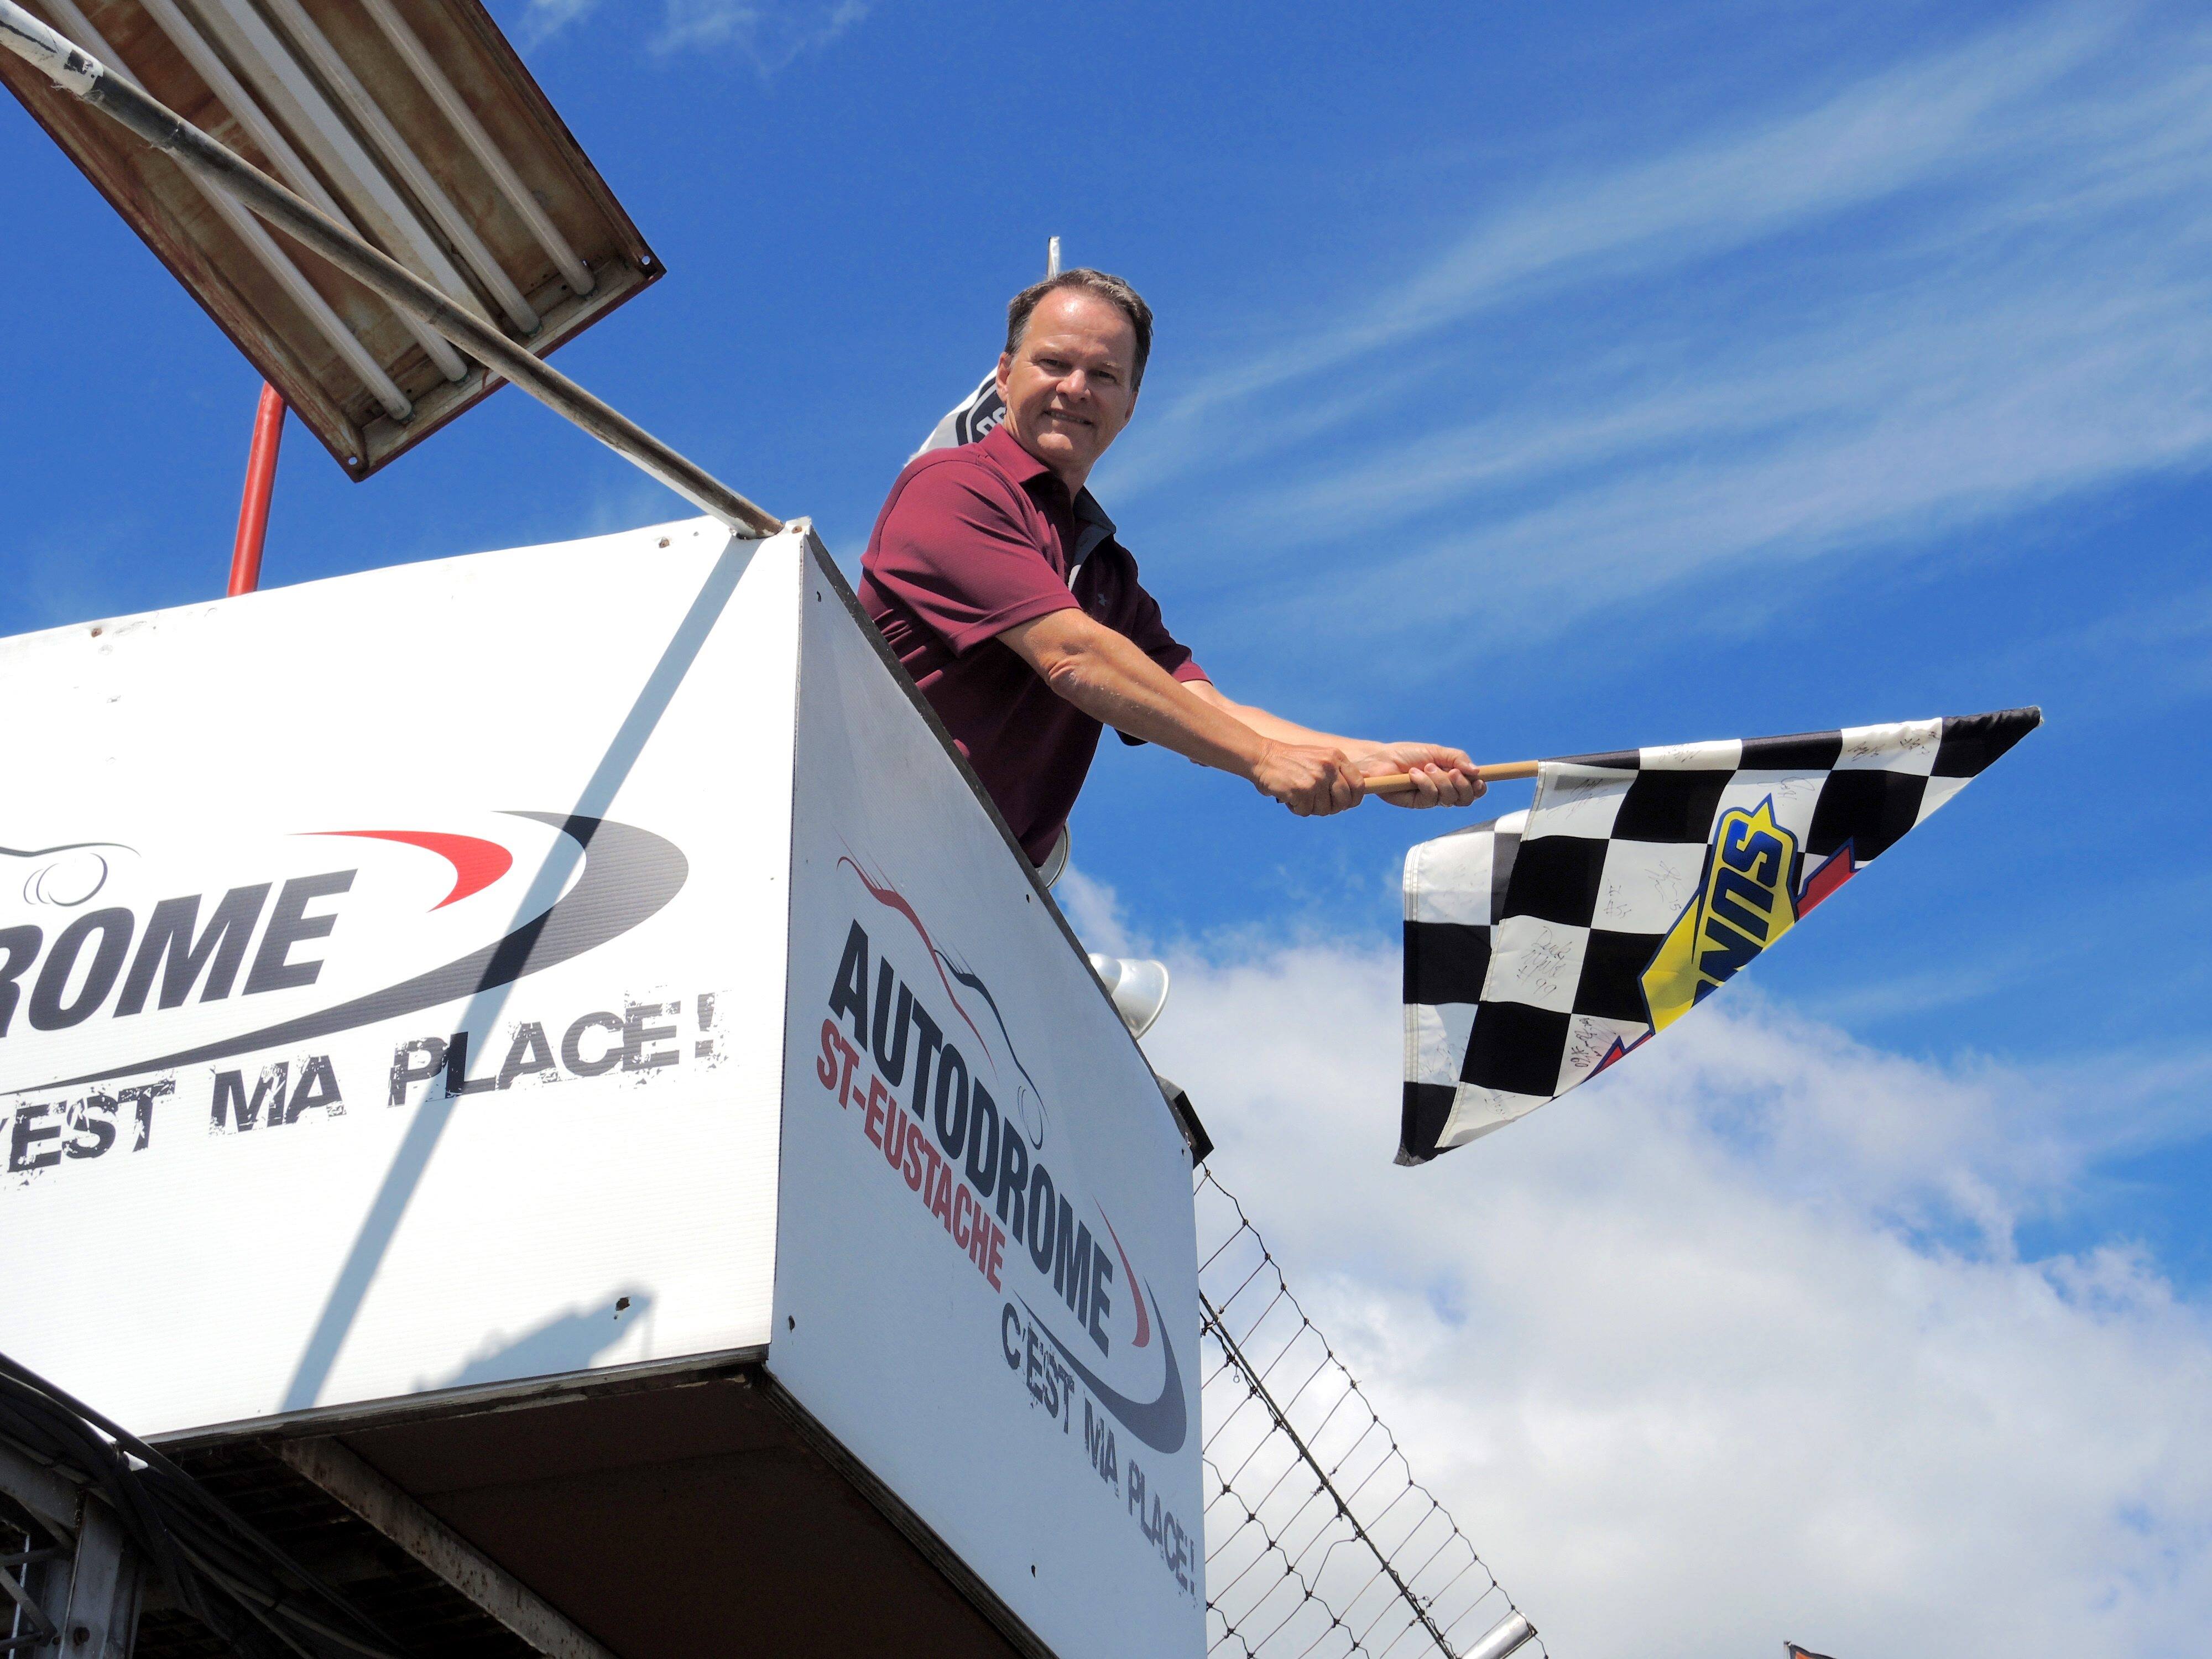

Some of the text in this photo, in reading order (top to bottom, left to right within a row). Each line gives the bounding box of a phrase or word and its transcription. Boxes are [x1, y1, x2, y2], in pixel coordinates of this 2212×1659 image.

[209, 1053, 346, 1137] MA
[387, 987, 726, 1108] PLACE!
[816, 1018, 1005, 1294] ST-EUSTACHE
[828, 918, 1113, 1359] AUTODROME
[1001, 1302, 1197, 1598] C'EST MA PLACE!
